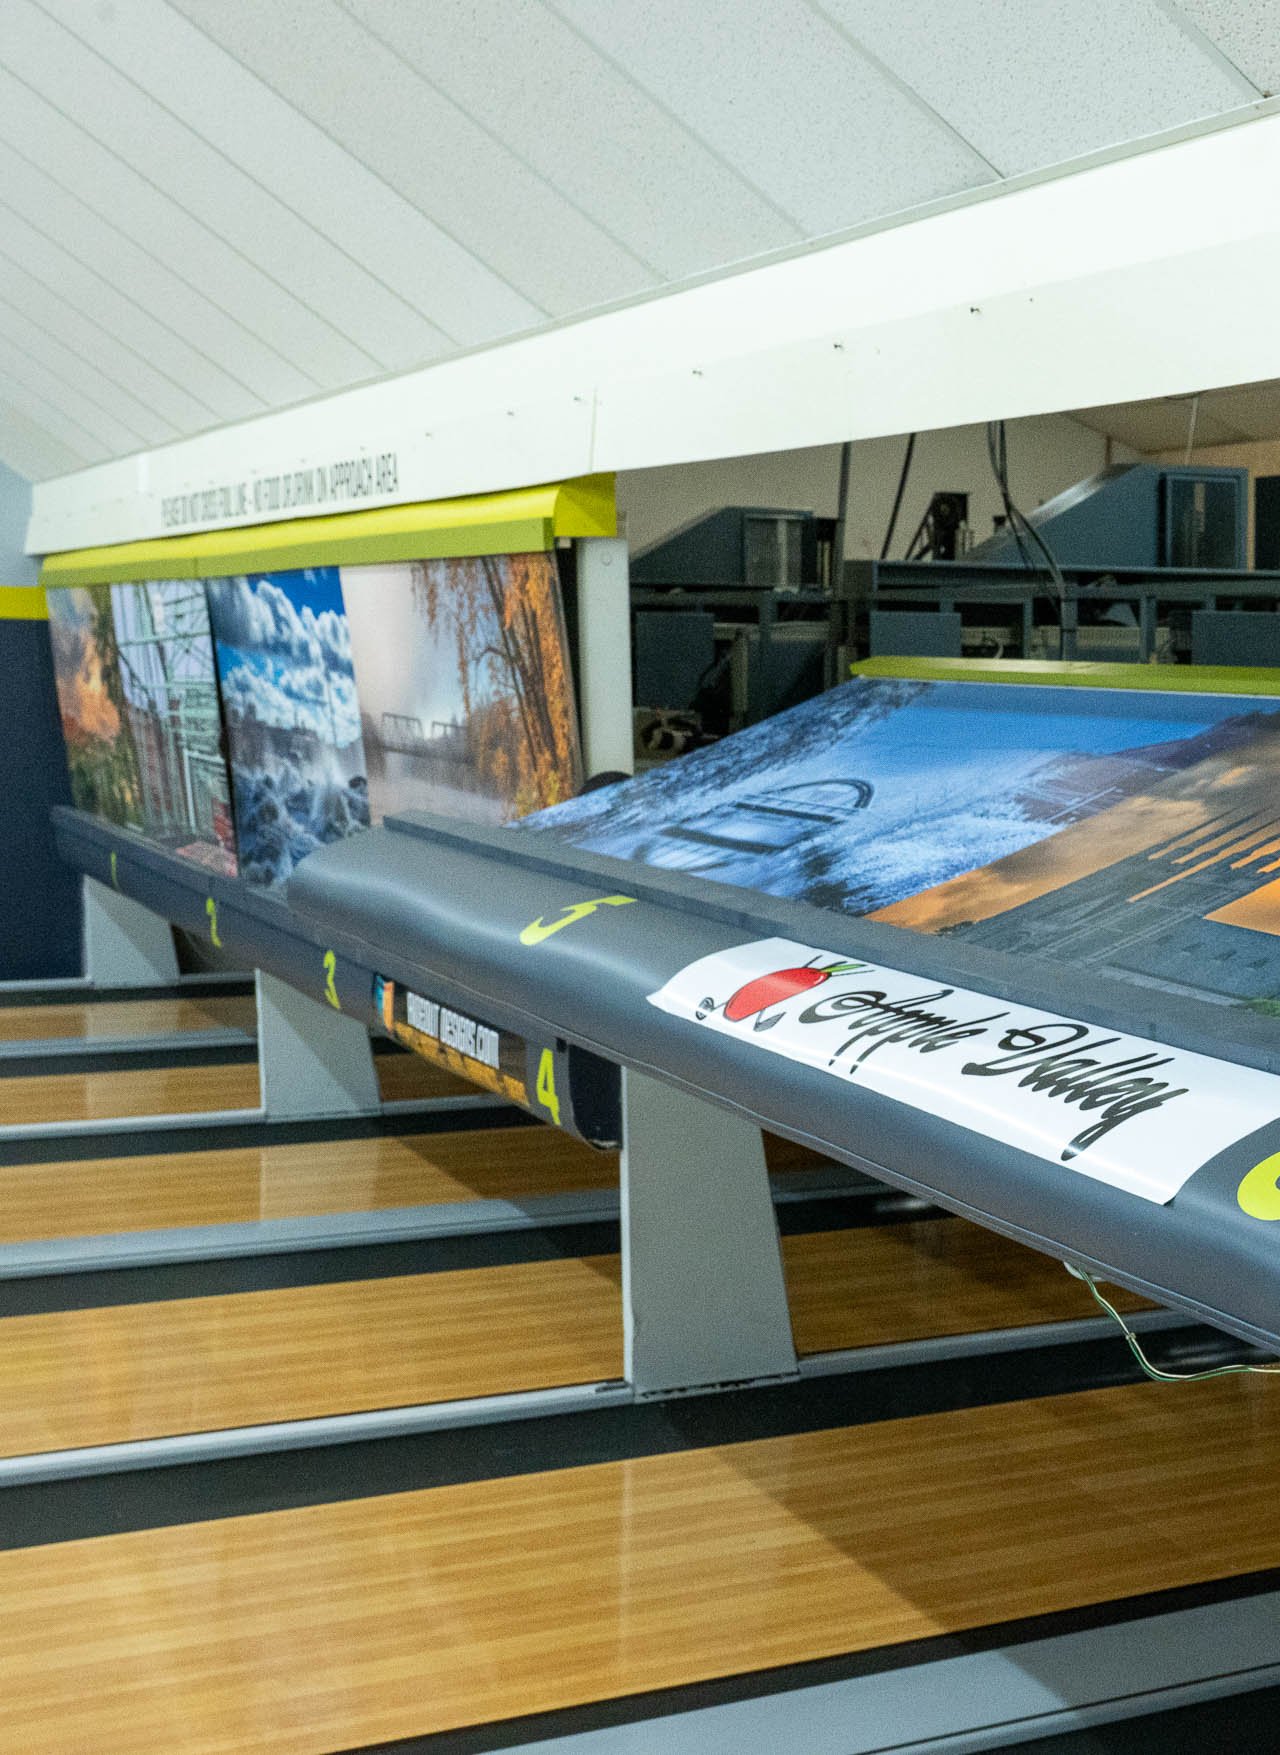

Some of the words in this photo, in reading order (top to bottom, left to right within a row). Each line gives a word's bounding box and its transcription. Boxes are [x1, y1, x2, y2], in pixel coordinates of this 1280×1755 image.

[330, 456, 376, 502] APPROACH
[376, 451, 400, 495] AREA
[519, 895, 638, 946] 5
[323, 950, 341, 1009] 3
[536, 1048, 561, 1125] 4
[799, 989, 1010, 1074] Apple
[961, 1023, 1189, 1161] Valley
